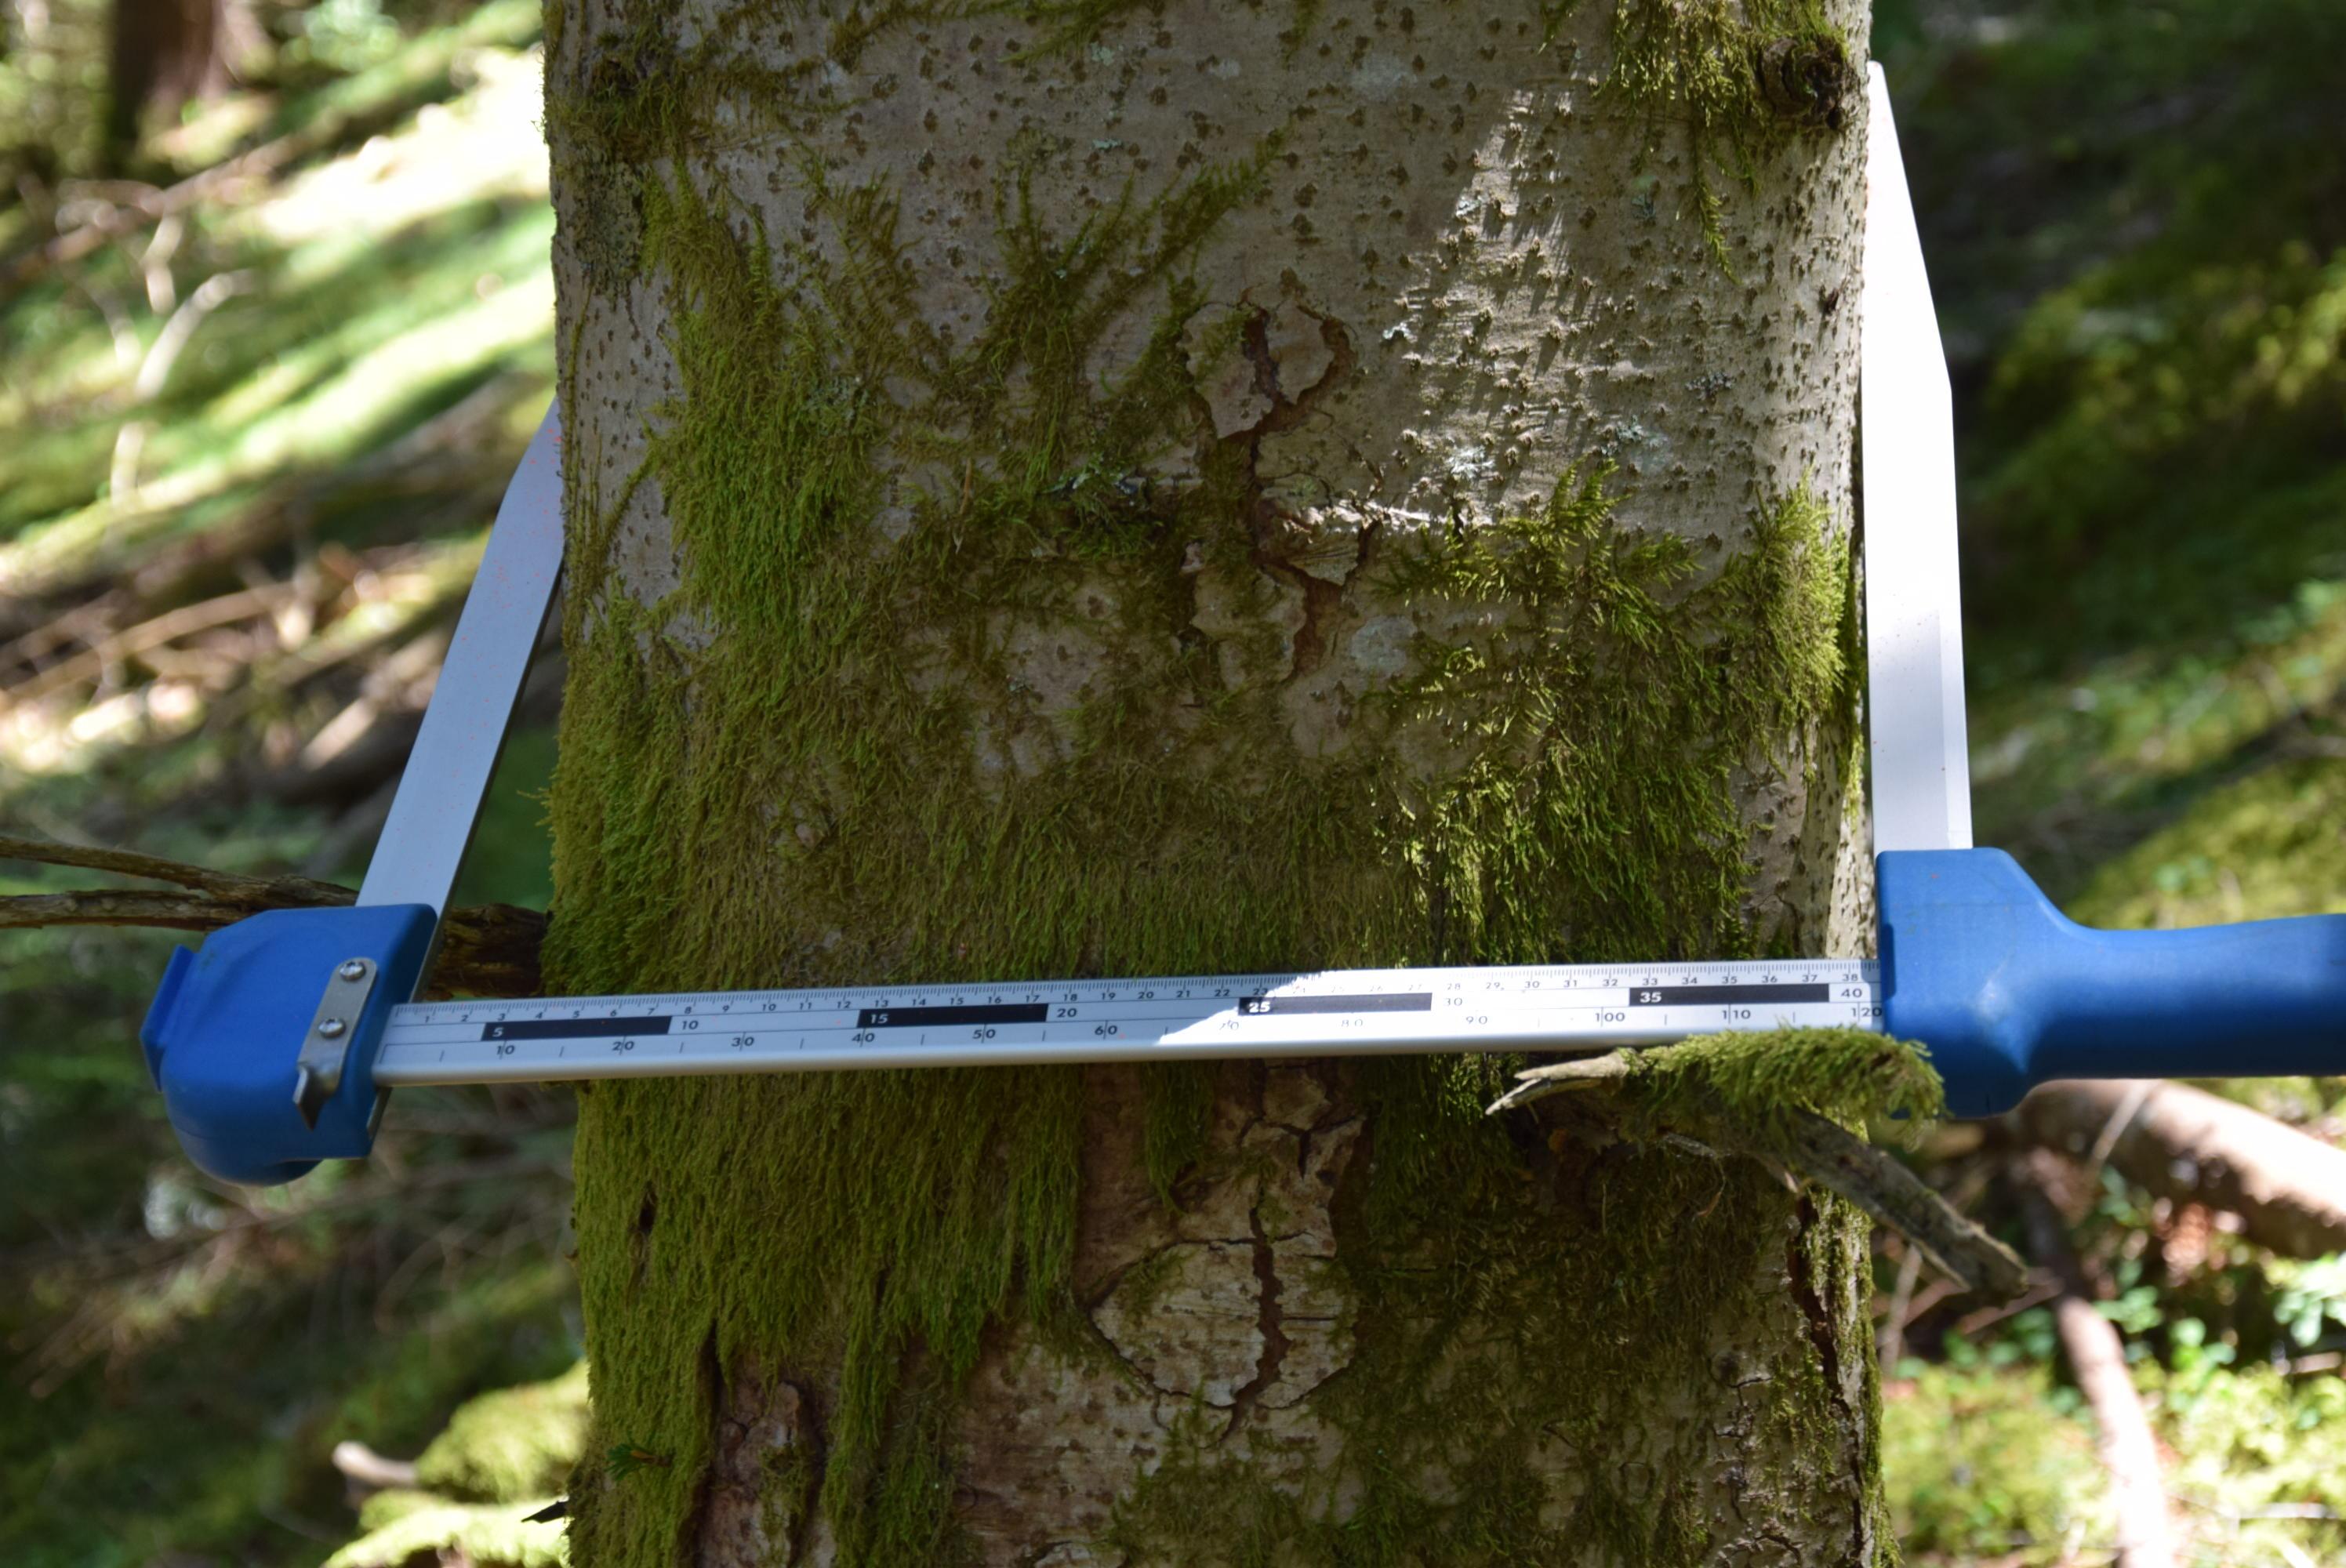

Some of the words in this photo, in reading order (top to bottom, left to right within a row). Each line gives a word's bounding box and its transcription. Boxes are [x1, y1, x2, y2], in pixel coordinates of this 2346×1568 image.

[492, 1027, 503, 1037] 5
[681, 1020, 699, 1030] 10
[870, 1014, 889, 1025] 15
[1056, 1008, 1077, 1018] 20
[1248, 1001, 1271, 1014] 25
[1640, 992, 1662, 1004] 35
[1841, 989, 1862, 998] 40
[761, 1003, 777, 1012] 10
[798, 1002, 813, 1011] 11
[836, 1000, 852, 1010] 12
[873, 999, 890, 1008] 13
[911, 998, 927, 1007] 14
[949, 996, 964, 1006] 15
[986, 996, 1003, 1004] 16
[1025, 994, 1040, 1004] 17
[1062, 993, 1079, 1002] 18
[1100, 992, 1117, 1000] 19
[1137, 991, 1155, 1000] 20
[1175, 989, 1191, 999] 21
[1214, 989, 1231, 998] 22
[1252, 987, 1269, 996] 23
[1446, 982, 1462, 991] 28
[1485, 981, 1502, 990] 29
[1523, 980, 1542, 989] 30
[1563, 979, 1579, 989] 31
[1602, 978, 1619, 988] 32
[1641, 977, 1659, 987] 33
[1681, 976, 1699, 985] 34
[1721, 975, 1738, 985] 35
[1761, 975, 1779, 984] 36
[1802, 974, 1818, 983] 37
[1842, 972, 1860, 982] 38
[496, 1044, 515, 1055] 10
[612, 1040, 634, 1051] 20
[731, 1036, 754, 1047] 30
[852, 1032, 875, 1043] 40
[972, 1029, 996, 1040] 50
[1094, 1025, 1118, 1036] 60
[1465, 1015, 1488, 1025] 90
[1595, 1011, 1625, 1022] 100
[1722, 1009, 1751, 1020] 110
[1851, 1007, 1882, 1018] 120
